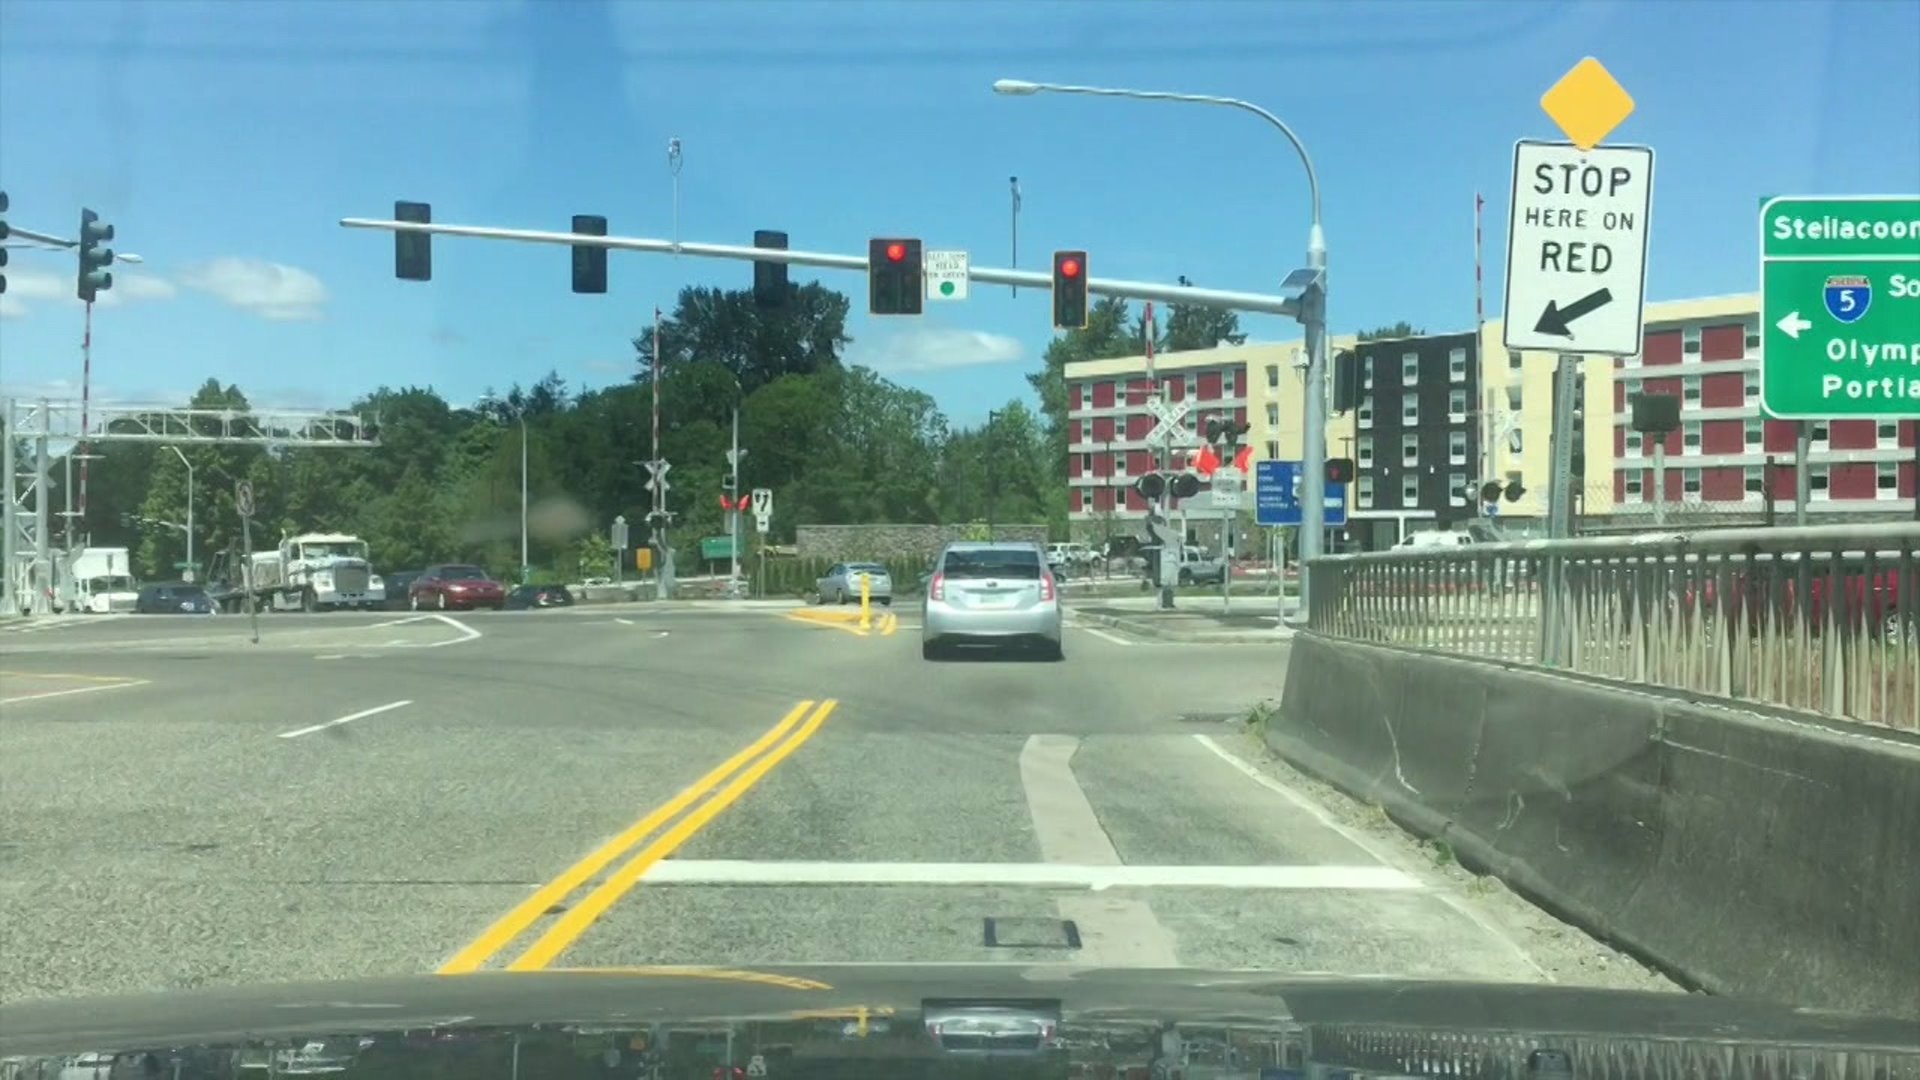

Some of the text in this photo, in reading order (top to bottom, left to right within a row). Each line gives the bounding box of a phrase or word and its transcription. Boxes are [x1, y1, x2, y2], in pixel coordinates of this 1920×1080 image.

[1534, 162, 1632, 197] STOP
[1525, 207, 1635, 232] HERE ON
[1540, 240, 1613, 274] RED
[1839, 289, 1856, 312] 5
